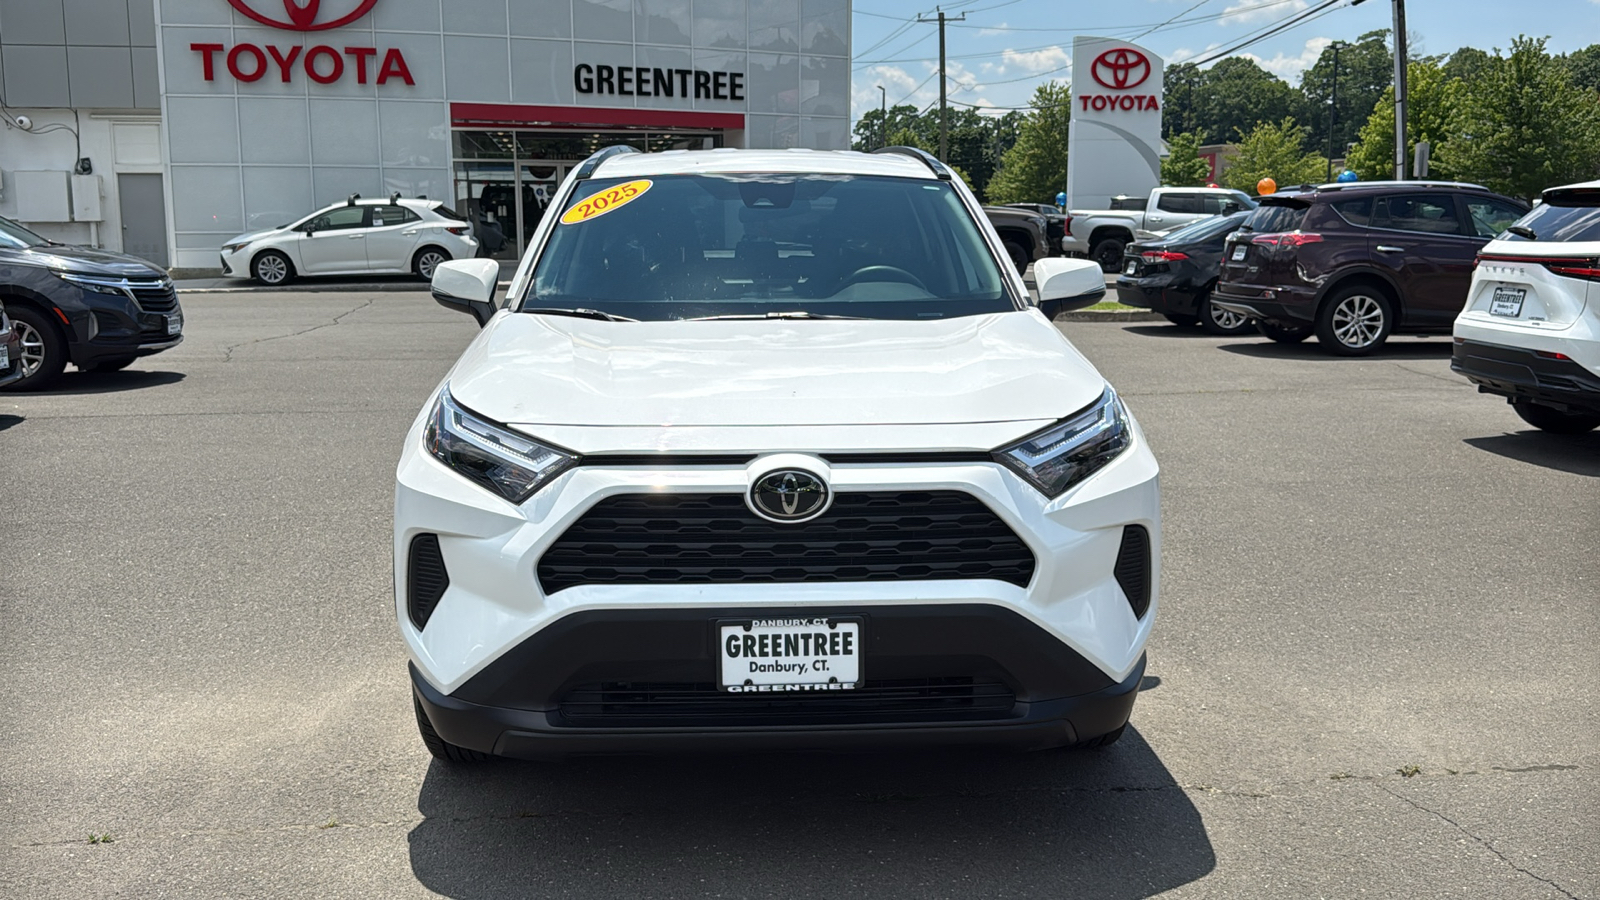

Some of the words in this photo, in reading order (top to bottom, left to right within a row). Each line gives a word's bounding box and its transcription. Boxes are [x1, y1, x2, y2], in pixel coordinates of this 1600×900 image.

[190, 43, 416, 86] TOYOTA
[574, 63, 746, 101] GREENTREE
[1079, 95, 1159, 111] TOYOTA
[578, 184, 638, 218] 2025
[752, 618, 810, 627] DANBURY,
[813, 618, 828, 626] CT
[726, 632, 853, 658] GREENTREE
[749, 660, 808, 675] Danbury,
[812, 660, 830, 671] CT.
[727, 682, 855, 693] GREENTREE
